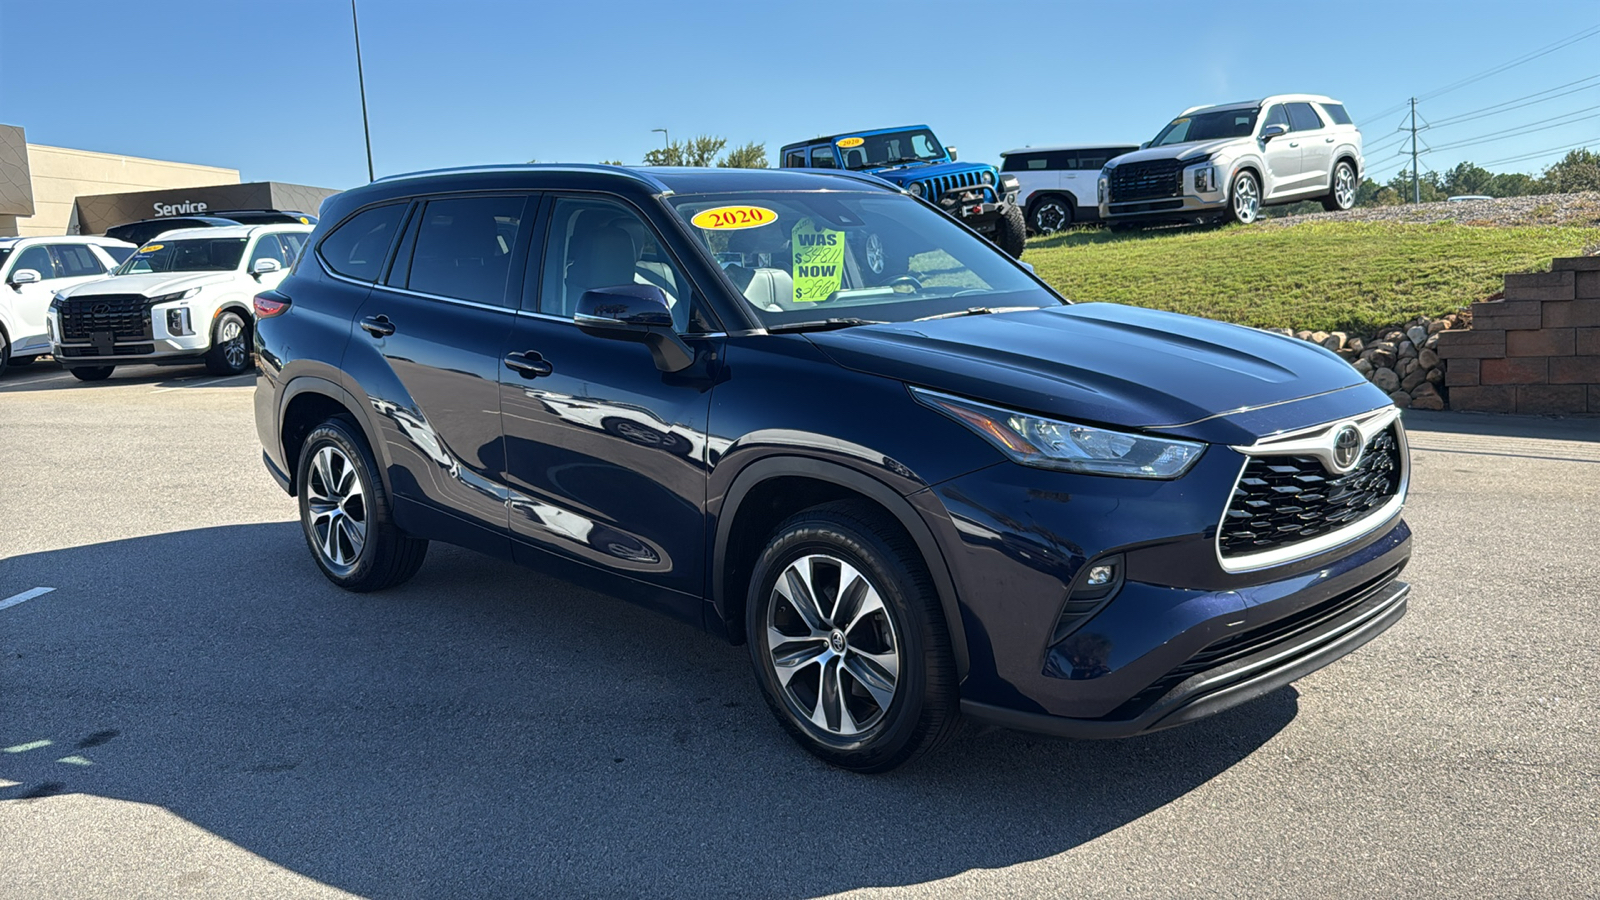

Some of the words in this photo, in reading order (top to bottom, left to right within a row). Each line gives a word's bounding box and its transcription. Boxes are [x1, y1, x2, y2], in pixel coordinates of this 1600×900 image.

[842, 138, 860, 147] 2020
[153, 200, 208, 217] Service
[709, 208, 763, 227] 2020
[798, 234, 837, 246] WAS
[798, 265, 836, 278] NOW
[764, 528, 808, 560] OPEN
